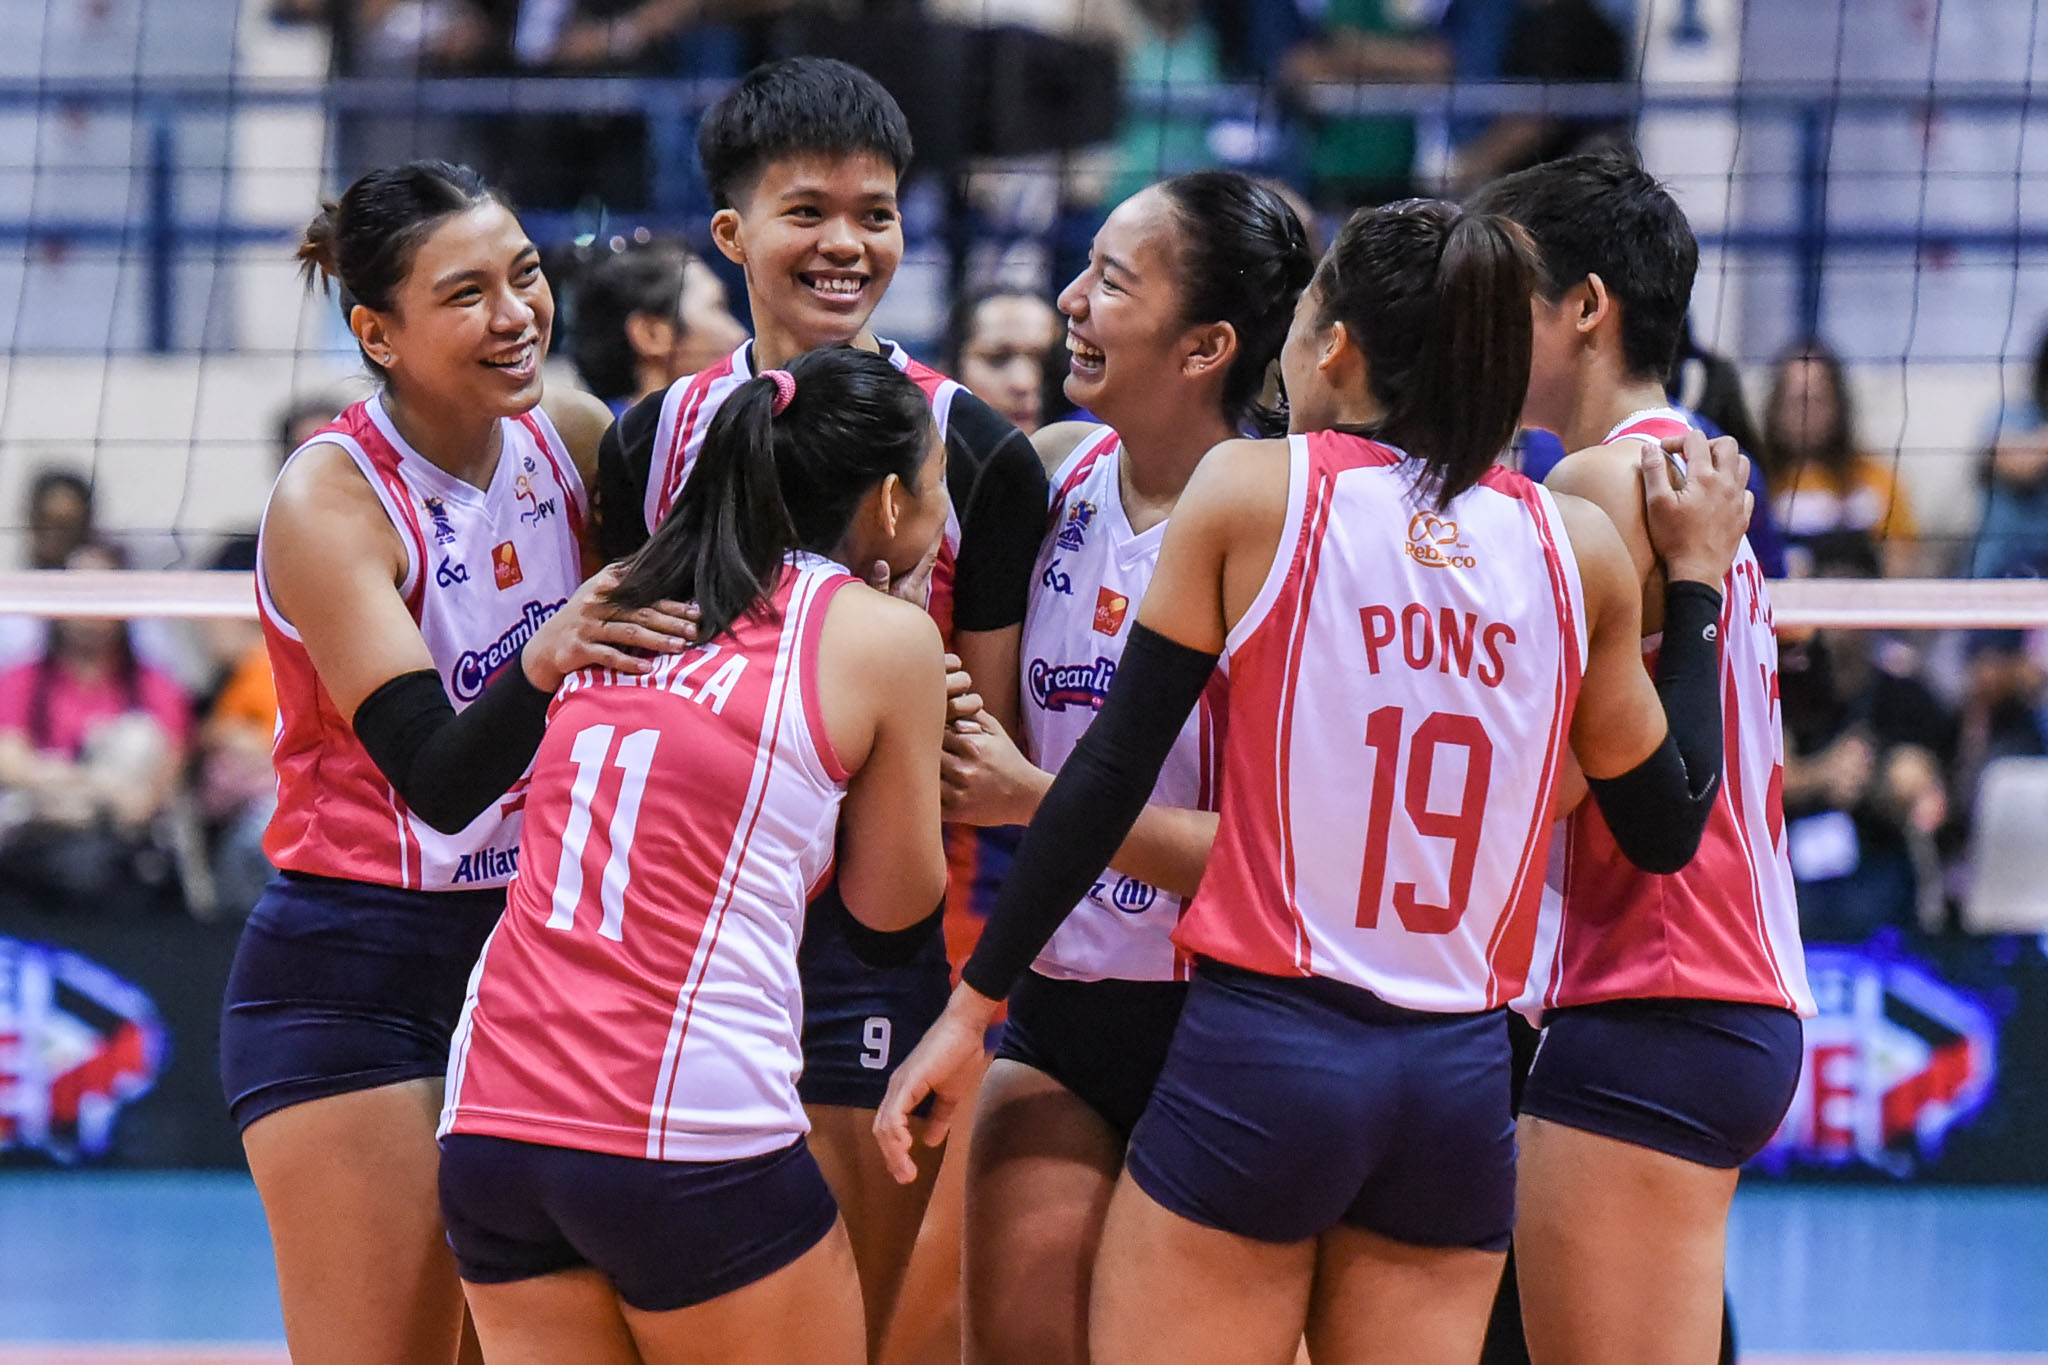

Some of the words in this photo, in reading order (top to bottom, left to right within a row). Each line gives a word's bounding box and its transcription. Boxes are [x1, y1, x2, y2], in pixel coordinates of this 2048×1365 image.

[1358, 602, 1517, 688] PONS
[545, 724, 662, 942] 11
[1355, 705, 1494, 935] 19
[860, 1016, 892, 1070] 9
